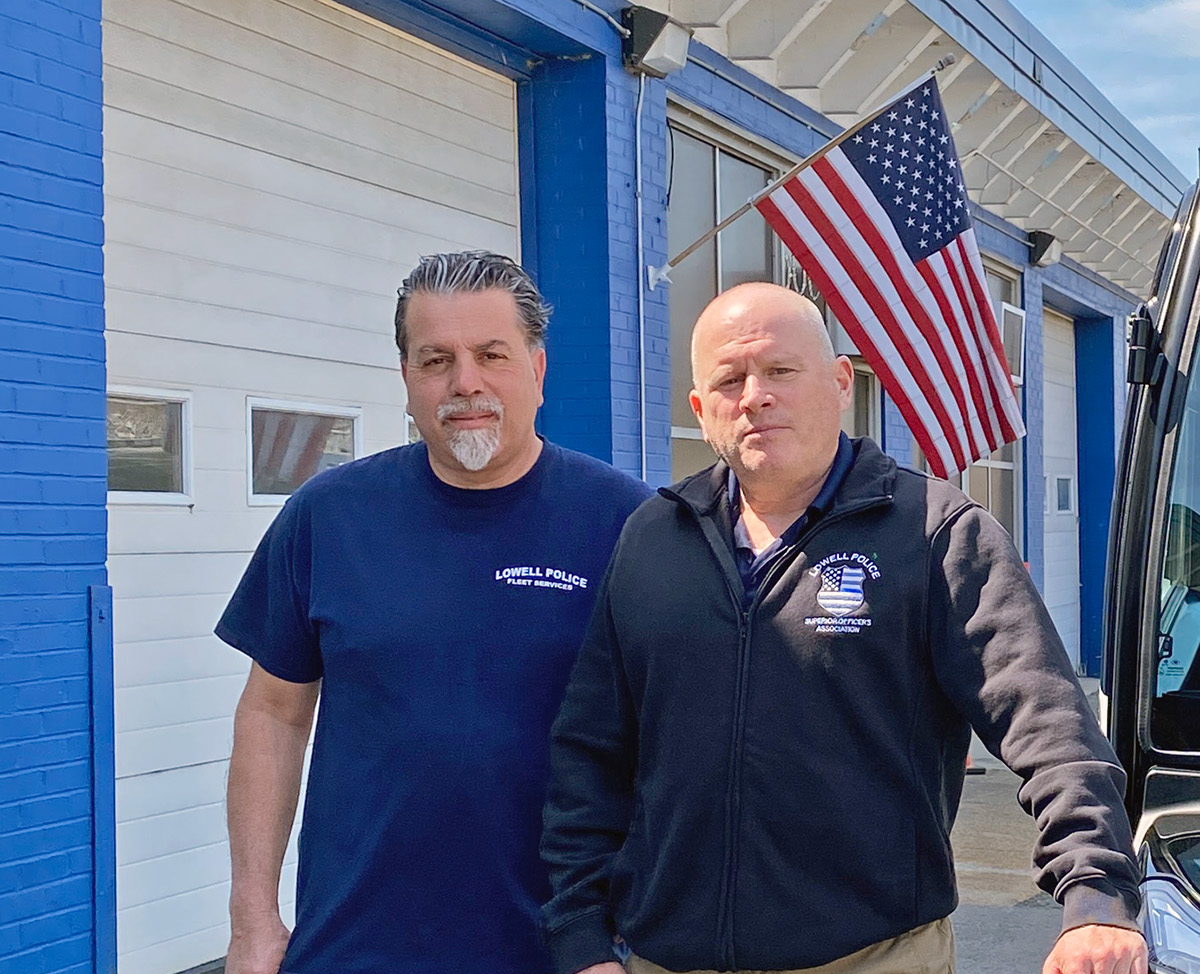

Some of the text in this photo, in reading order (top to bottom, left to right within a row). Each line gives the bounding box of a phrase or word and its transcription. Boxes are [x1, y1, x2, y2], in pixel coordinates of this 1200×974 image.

[809, 552, 881, 580] LOWELL POLICE
[495, 566, 588, 588] LOWELL POLICE
[507, 578, 573, 591] FLEET SERVICES
[804, 617, 837, 625] SUPERIOR
[815, 625, 860, 633] ASSOCIATION
